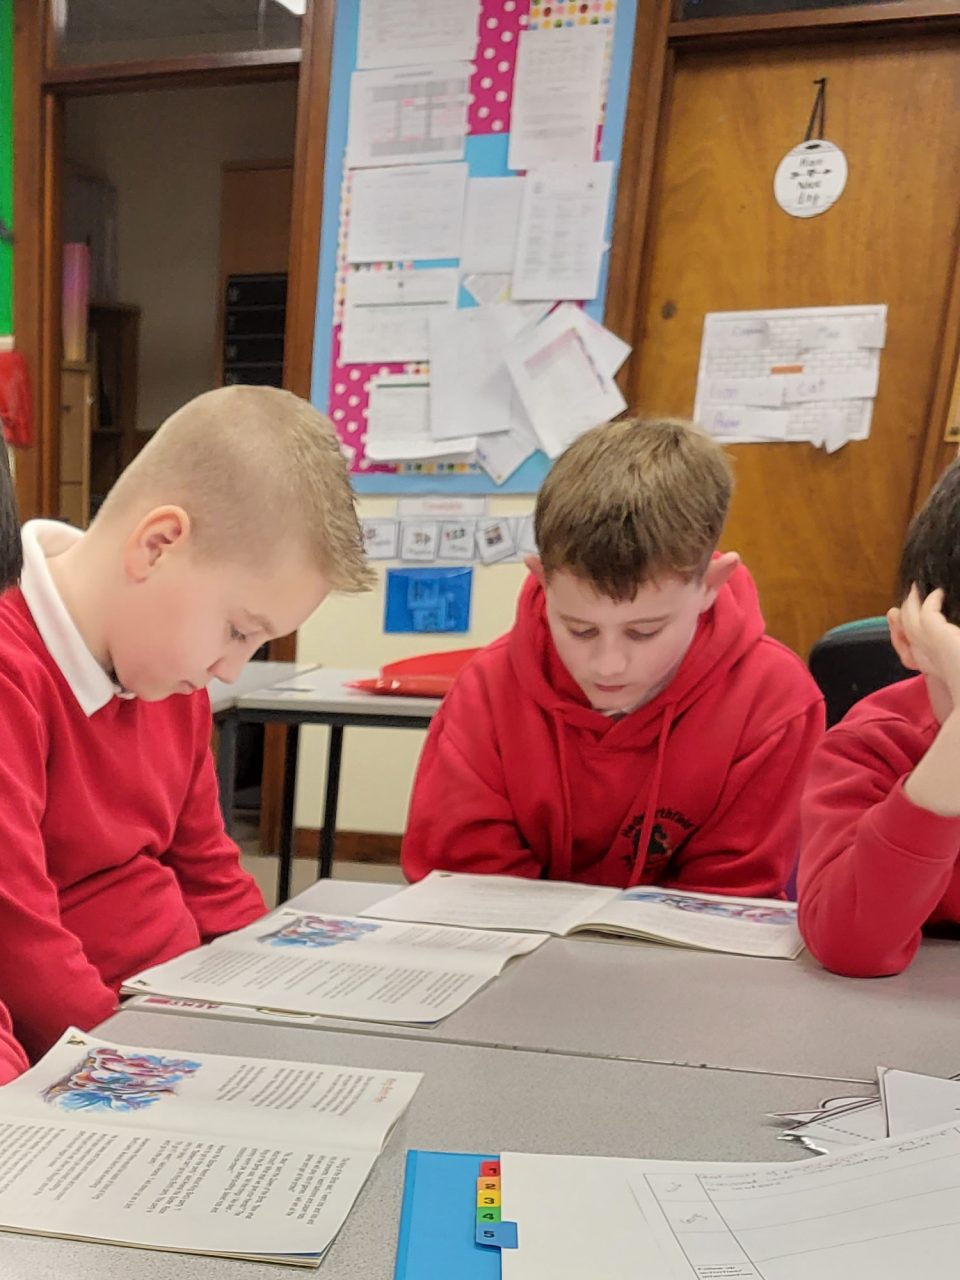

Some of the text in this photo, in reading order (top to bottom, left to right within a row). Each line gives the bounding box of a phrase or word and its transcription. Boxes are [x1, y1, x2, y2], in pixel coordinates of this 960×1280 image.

[483, 1197, 495, 1205] 3
[481, 1212, 495, 1220] 4
[483, 1230, 496, 1238] 5
